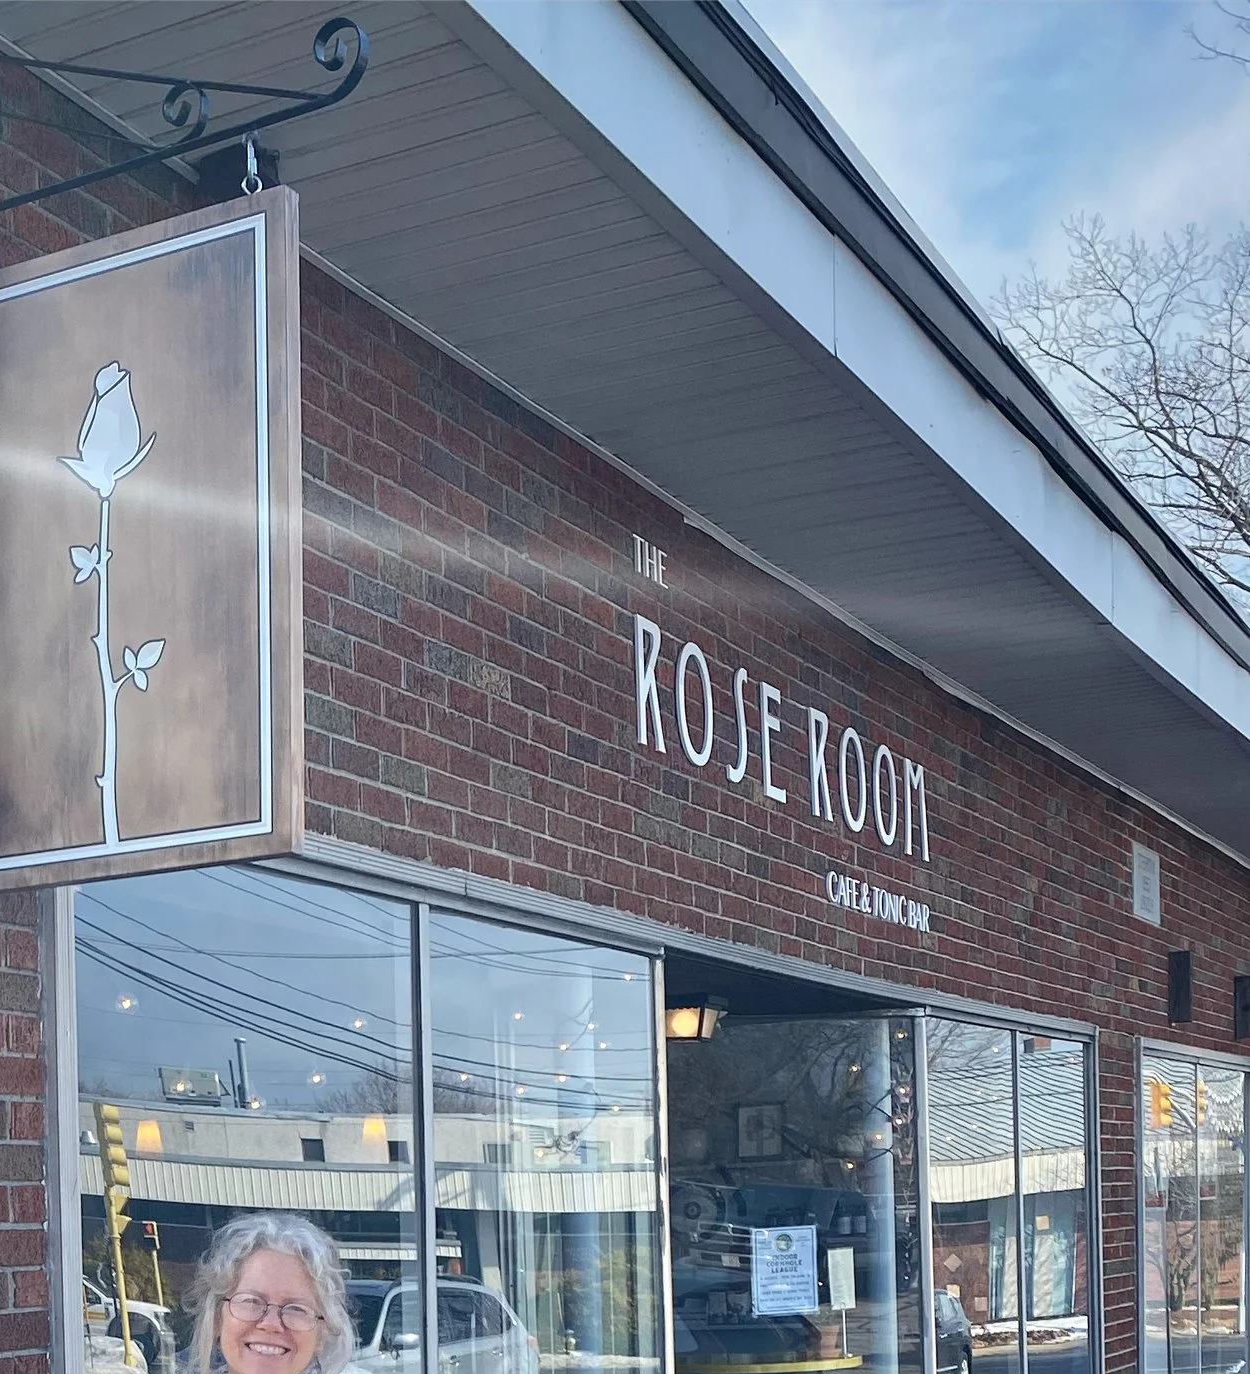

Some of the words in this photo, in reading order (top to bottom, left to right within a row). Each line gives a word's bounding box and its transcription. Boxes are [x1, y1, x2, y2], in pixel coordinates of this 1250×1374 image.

[632, 533, 669, 590] THE
[633, 613, 788, 805] ROSE
[806, 705, 931, 863] ROOM
[826, 870, 861, 910] CAFE
[860, 882, 872, 914] &
[871, 886, 907, 925] TONIC
[907, 899, 930, 934] BAR
